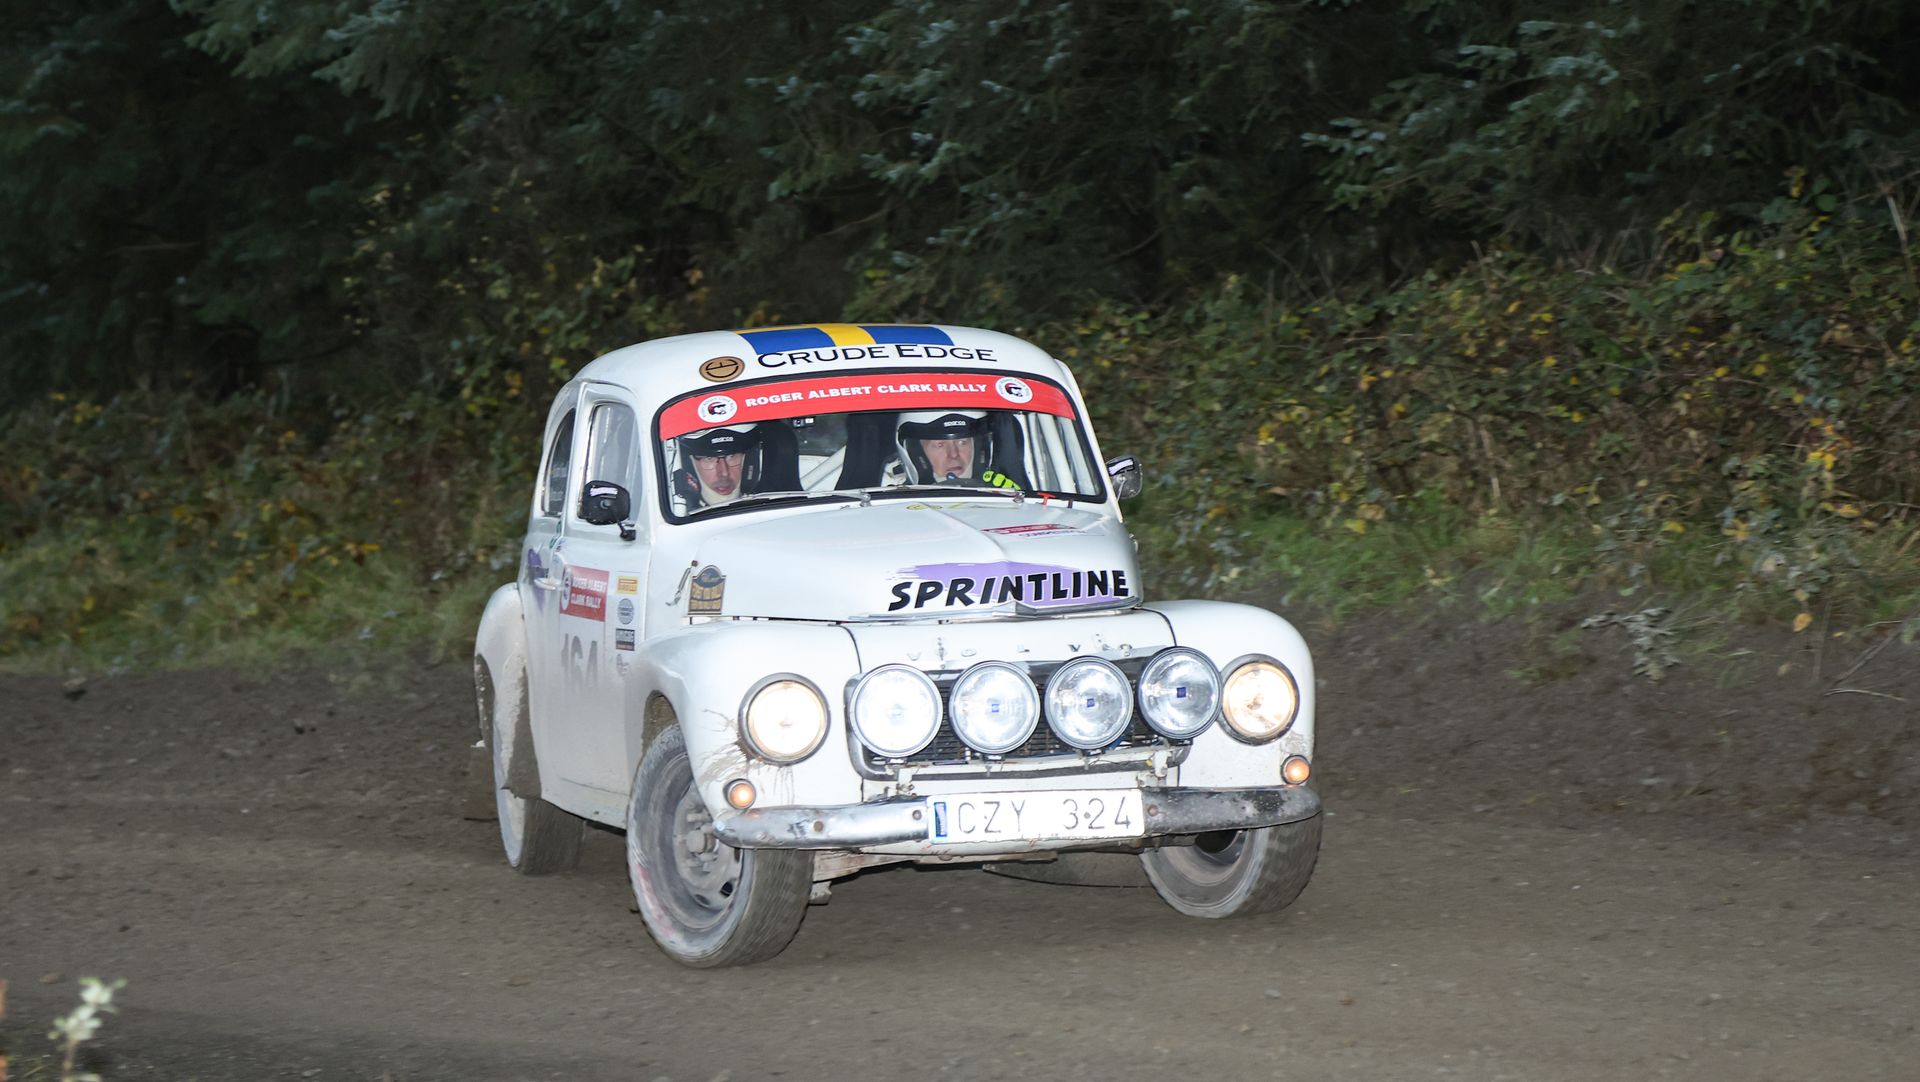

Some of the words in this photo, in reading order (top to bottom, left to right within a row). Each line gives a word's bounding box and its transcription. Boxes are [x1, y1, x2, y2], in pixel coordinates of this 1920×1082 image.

[758, 346, 890, 368] CRUDE
[893, 344, 998, 362] EDGE
[745, 391, 804, 407] ROGER
[808, 386, 872, 399] ALBERT
[877, 383, 933, 393] CLARK
[937, 383, 987, 392] RALLY
[888, 570, 1129, 612] SPRINTLINE
[958, 799, 1026, 834] CZY
[1062, 796, 1132, 830] 324
